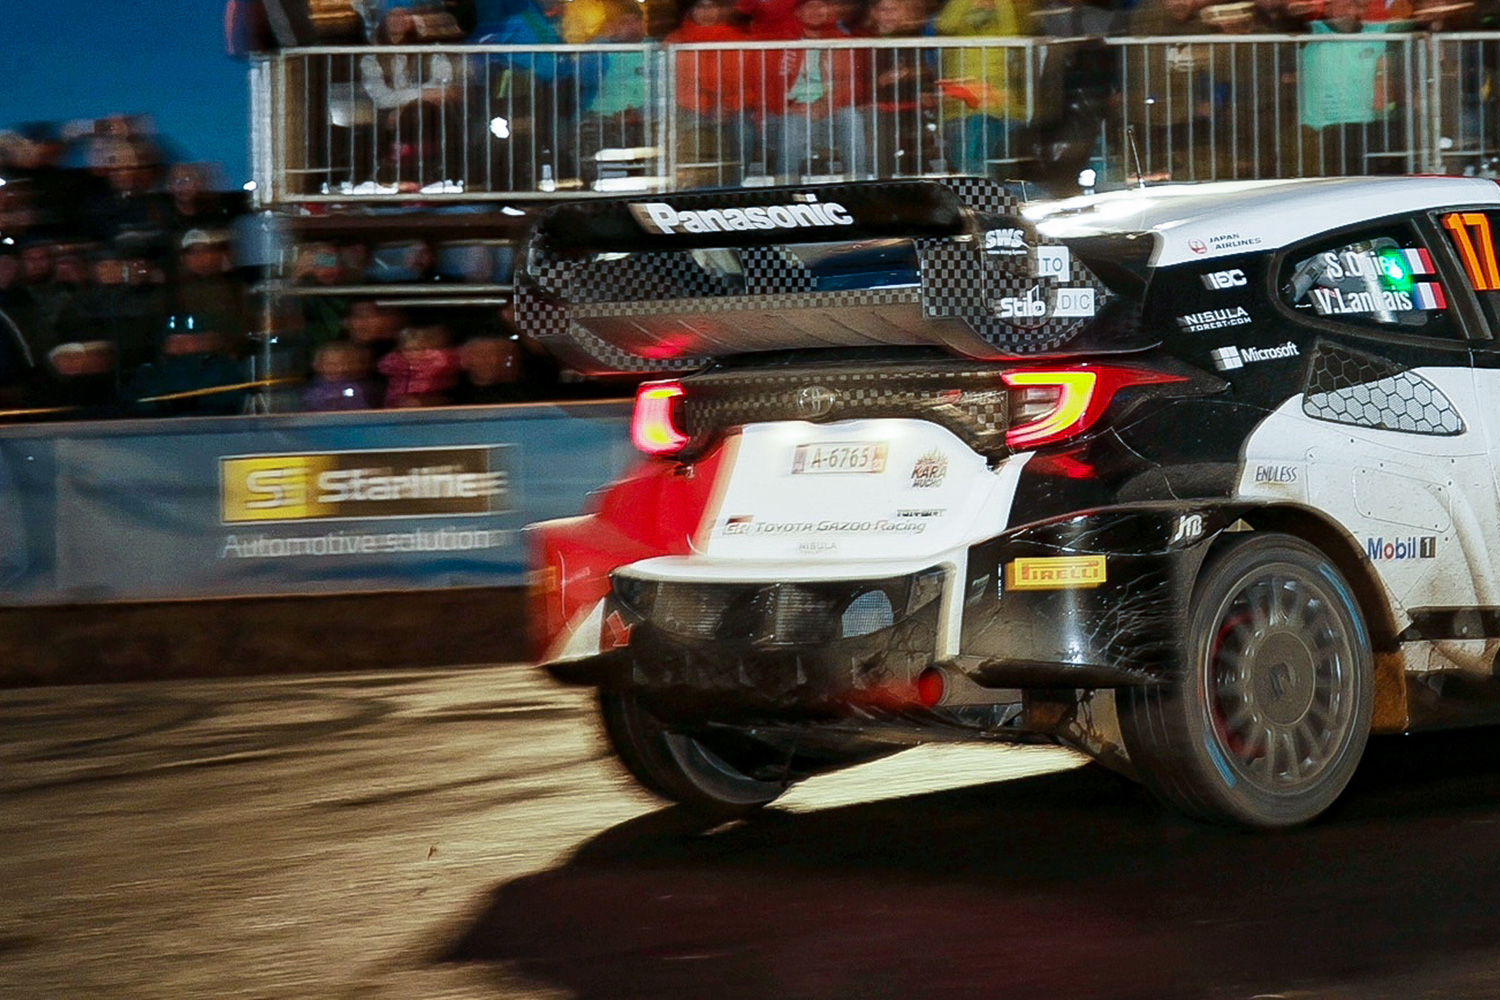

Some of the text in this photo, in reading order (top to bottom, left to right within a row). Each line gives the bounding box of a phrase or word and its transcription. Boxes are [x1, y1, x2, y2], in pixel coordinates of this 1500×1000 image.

[646, 194, 854, 234] Panasonic
[985, 228, 1027, 248] SWS
[1209, 232, 1240, 243] JAPAN
[1215, 237, 1262, 250] AIRLINES
[1324, 250, 1404, 282] S.Ogie
[1000, 284, 1046, 317] Stilo
[1183, 306, 1250, 326] NISULA
[1241, 341, 1301, 362] Microsoft
[911, 465, 948, 479] KARA
[1255, 465, 1298, 482] ENDLESS
[317, 465, 505, 503] Starline
[755, 521, 813, 533] TOYOTA
[816, 520, 872, 532] GAZOO
[873, 519, 927, 534] Racing
[1173, 514, 1203, 541] JTB
[221, 530, 377, 558] Automotive
[1367, 537, 1416, 560] Mobil
[1021, 559, 1100, 581] PIRELLI
